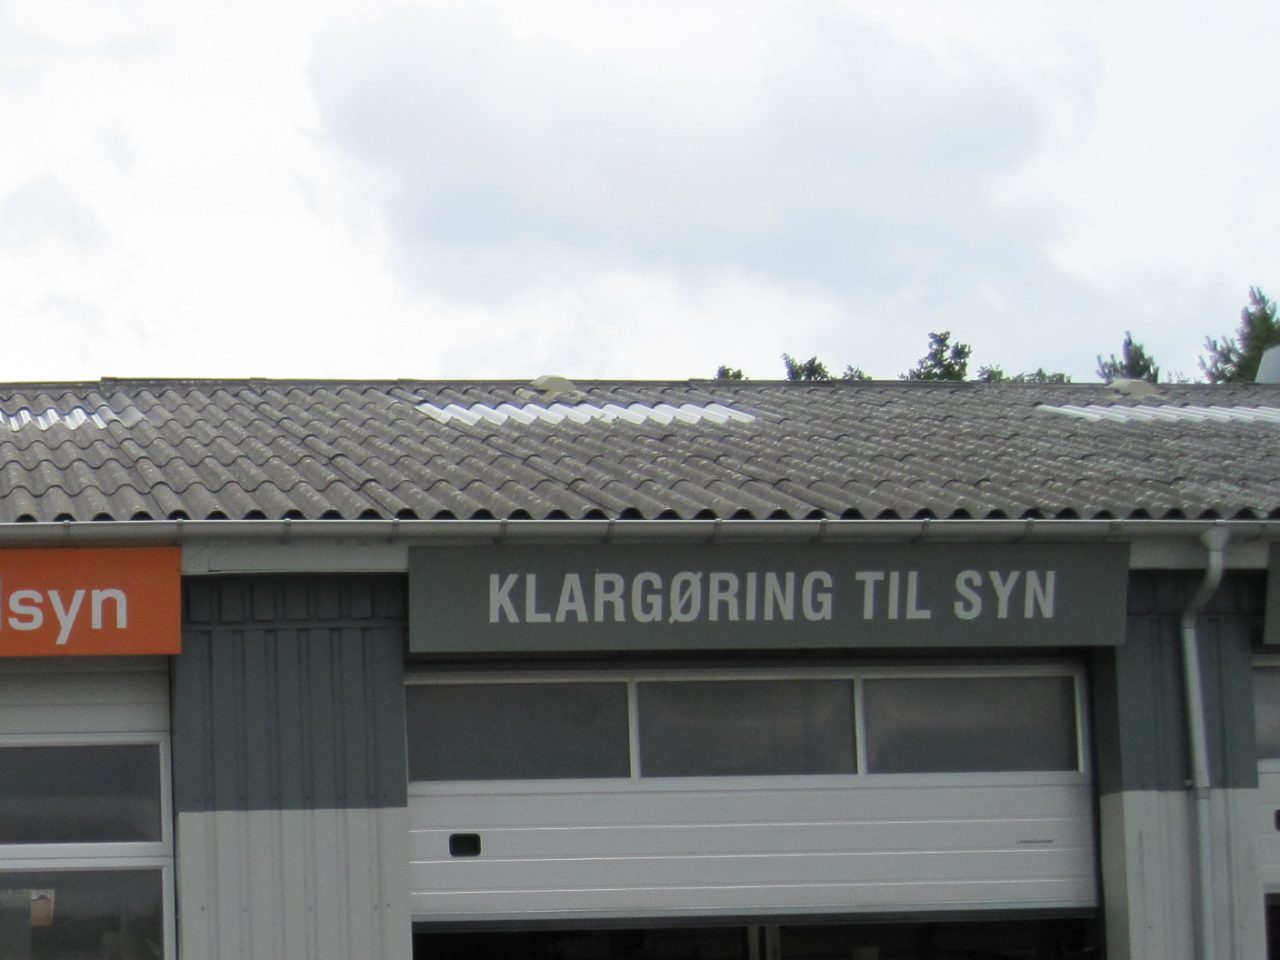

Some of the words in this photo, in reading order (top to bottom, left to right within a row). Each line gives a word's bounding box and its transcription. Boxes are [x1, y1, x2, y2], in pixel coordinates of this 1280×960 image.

[488, 569, 833, 625] KLARGØRING
[855, 570, 931, 620] TIL
[953, 569, 1057, 620] SYN
